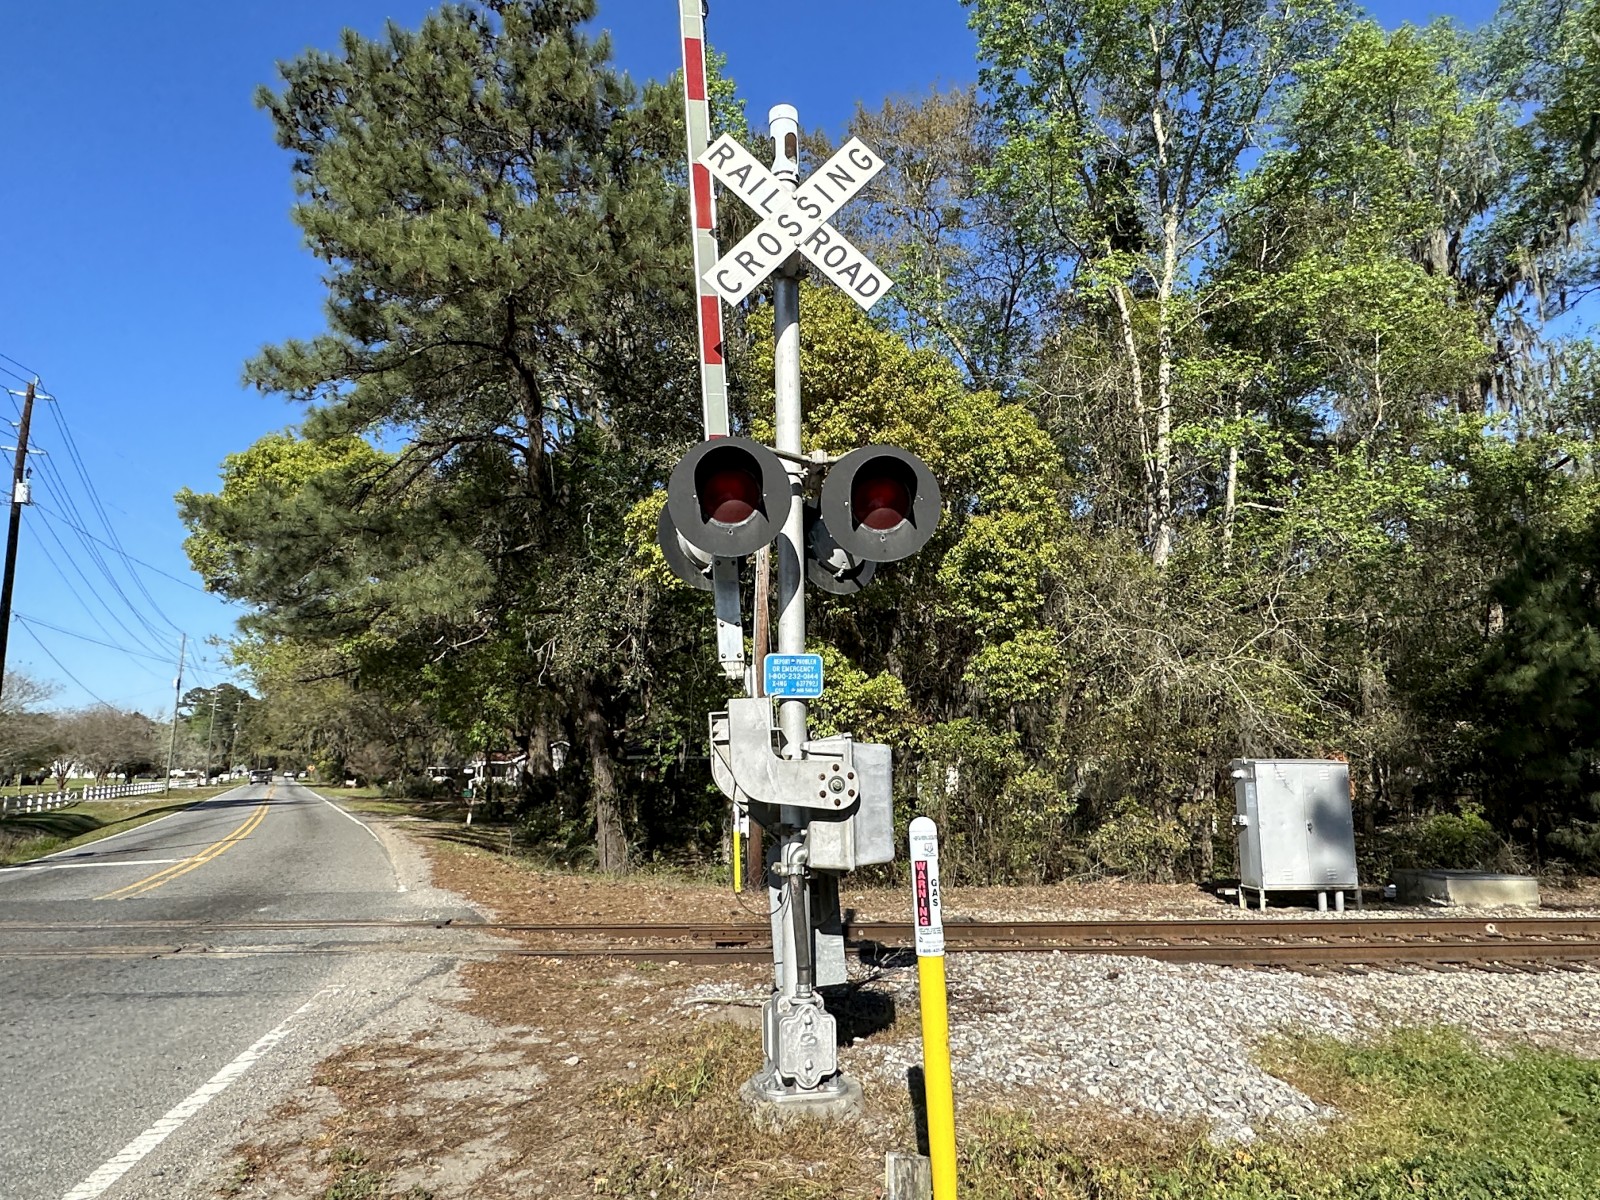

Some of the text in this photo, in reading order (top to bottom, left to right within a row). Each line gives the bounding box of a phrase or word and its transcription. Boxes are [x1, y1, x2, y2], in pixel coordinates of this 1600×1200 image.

[708, 142, 780, 214] RAIL
[716, 148, 873, 294] CROSSING
[804, 227, 881, 298] ROAD
[916, 862, 928, 926] WARNING
[930, 878, 939, 907] GAS
